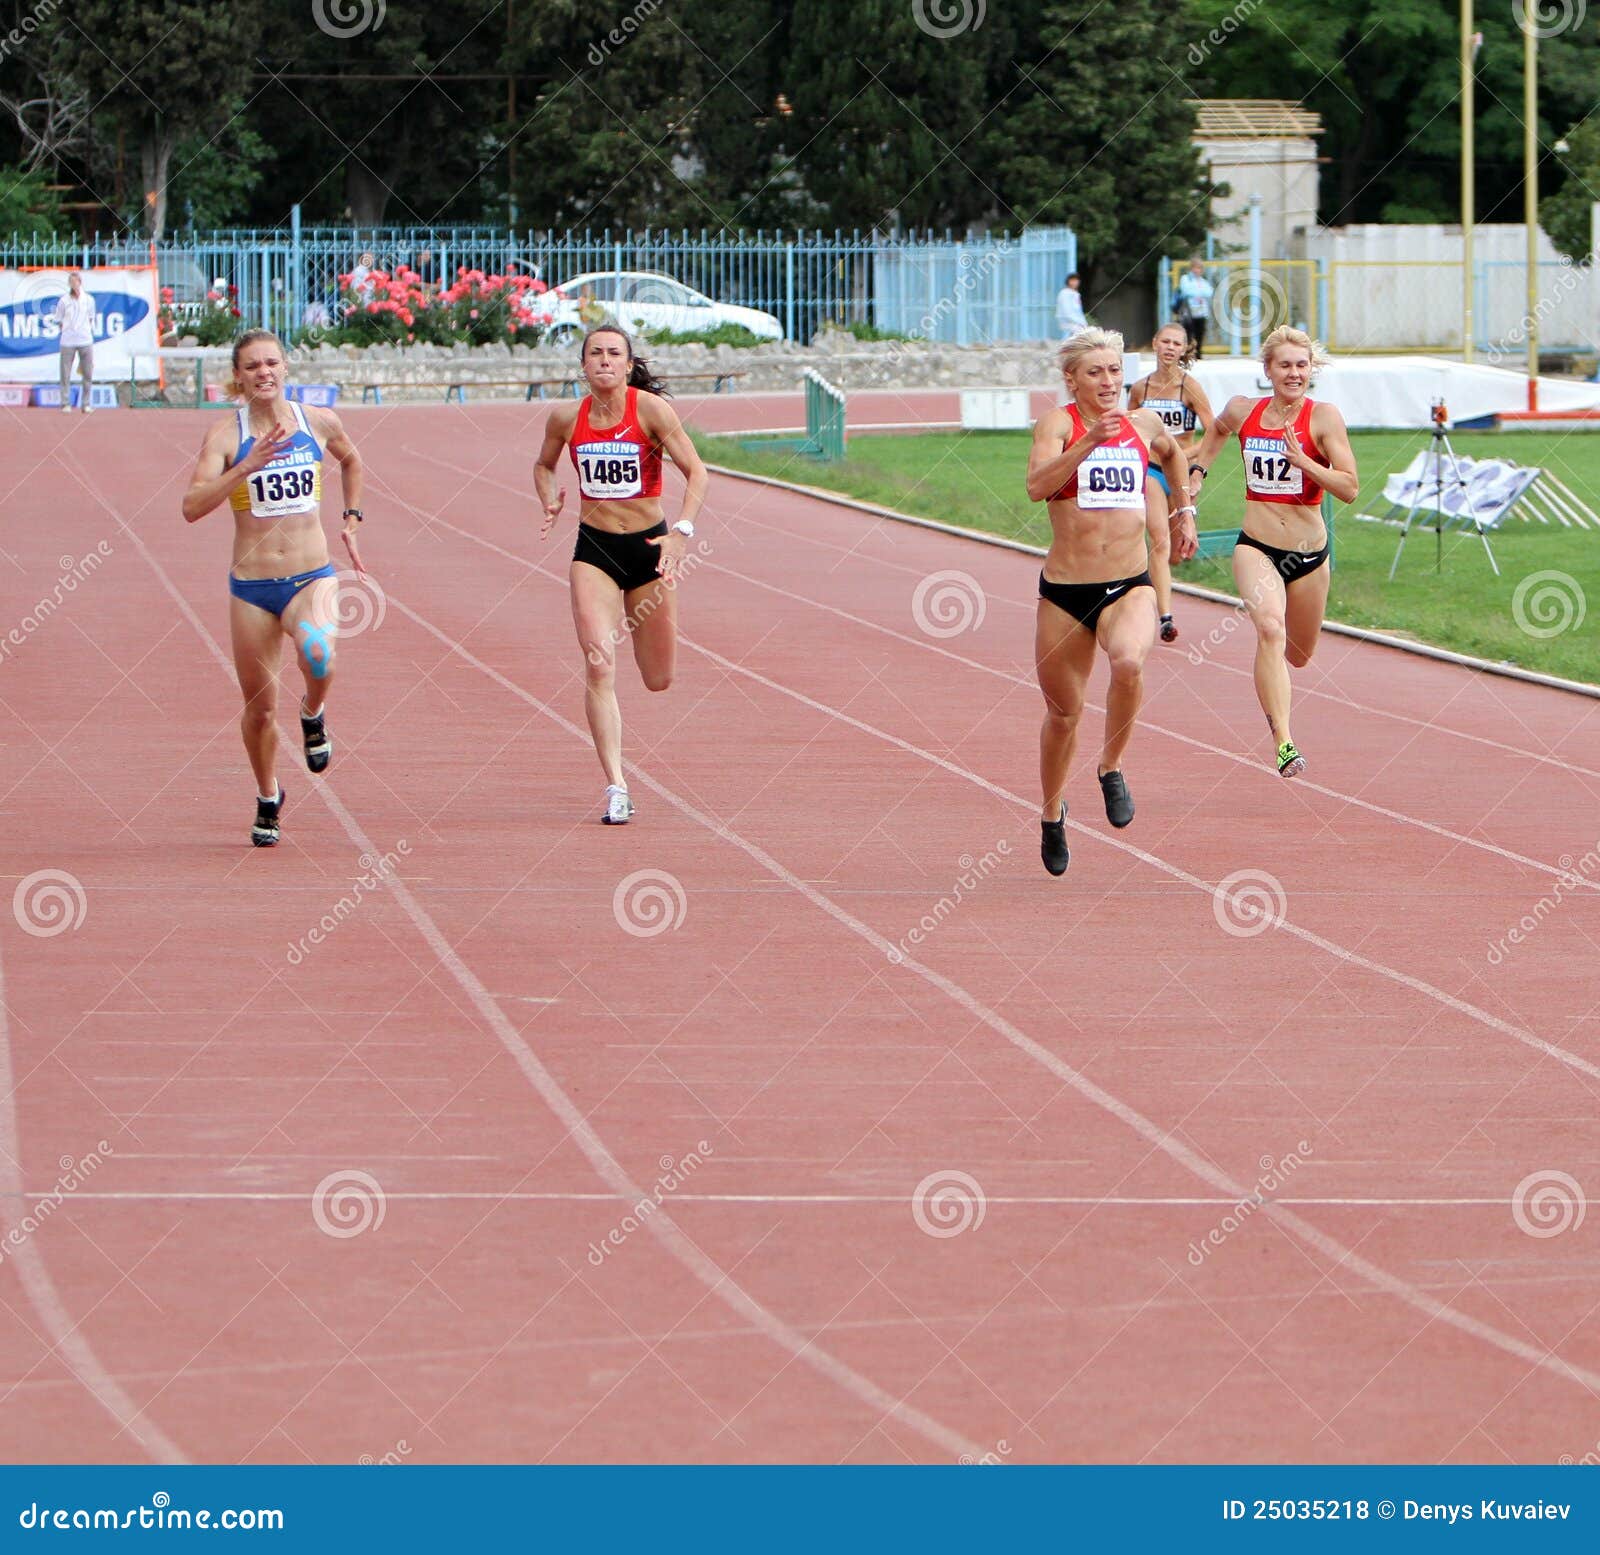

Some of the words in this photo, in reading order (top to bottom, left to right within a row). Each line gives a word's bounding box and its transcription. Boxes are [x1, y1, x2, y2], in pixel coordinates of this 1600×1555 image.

[1155, 411, 1182, 427] 49
[576, 441, 640, 454] SAMSUNG
[1245, 437, 1288, 452] SAMSU
[580, 458, 638, 484] 1485
[1089, 466, 1135, 493] 699
[1252, 456, 1291, 482] 412
[251, 469, 314, 502] 1338
